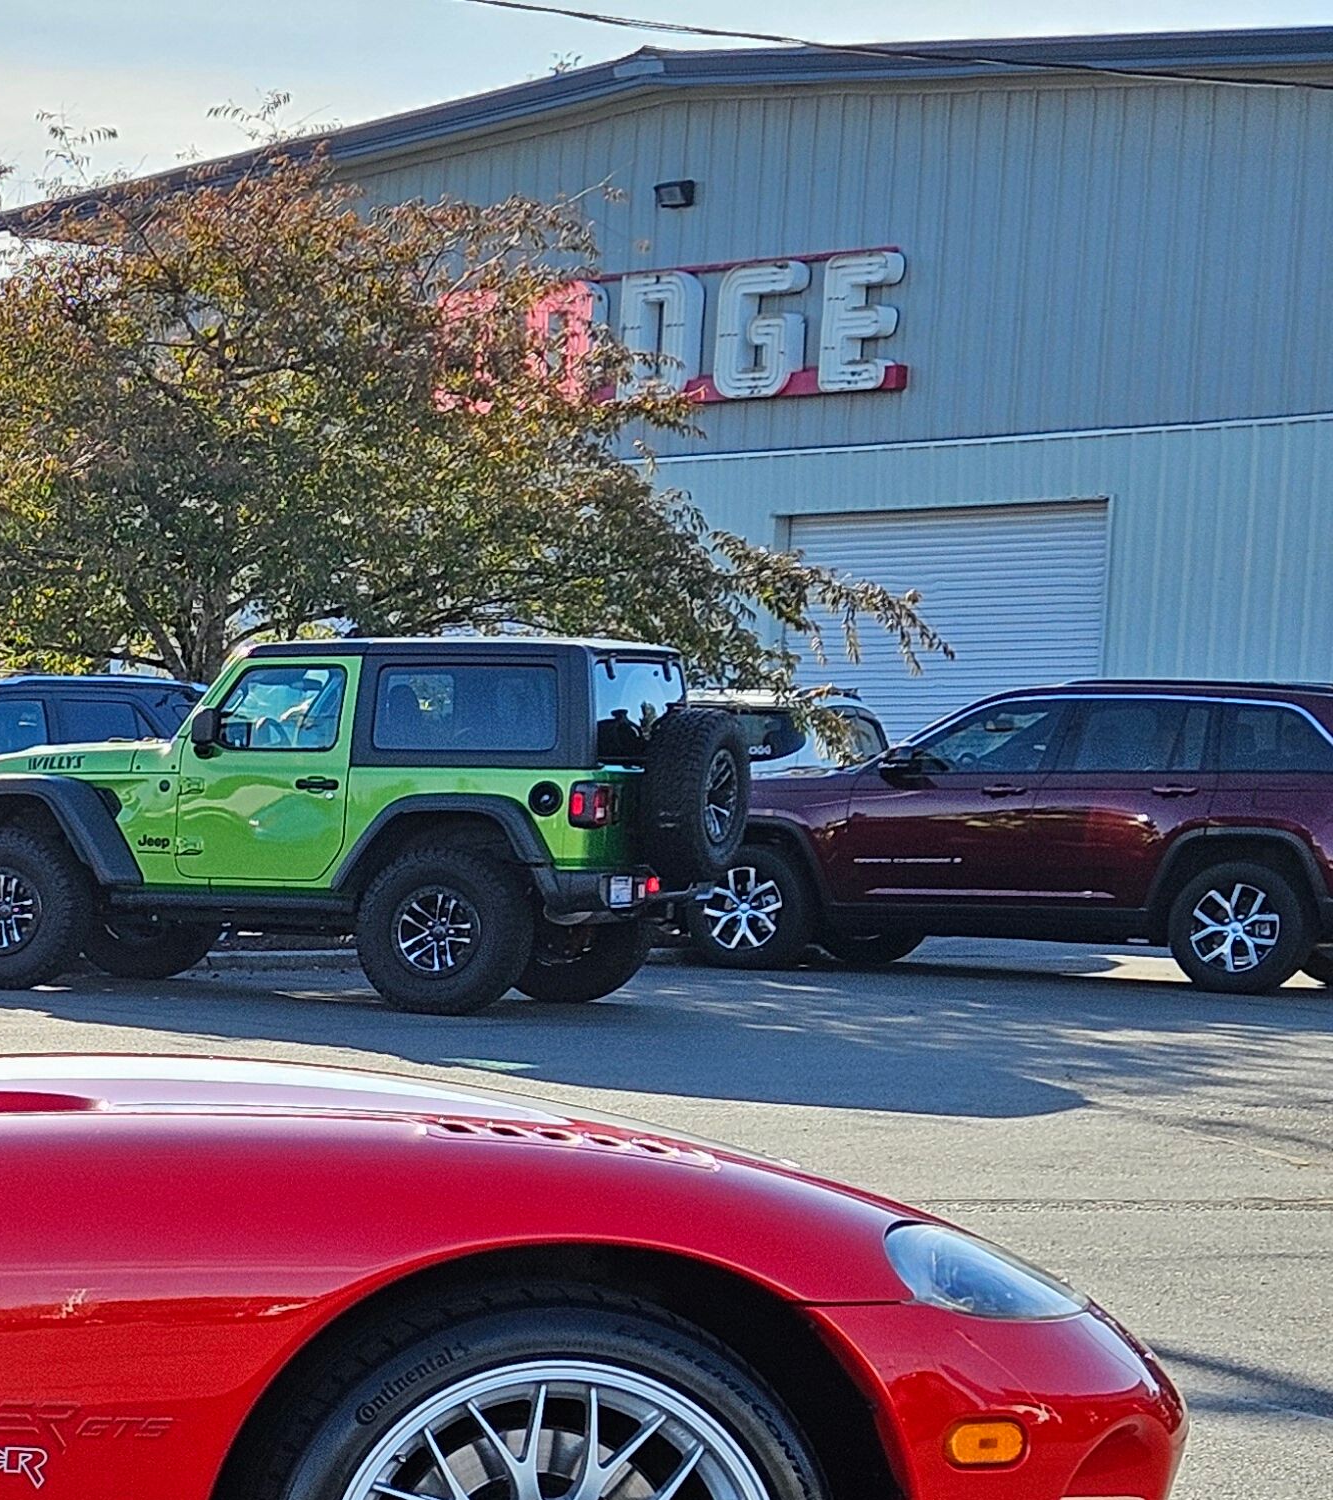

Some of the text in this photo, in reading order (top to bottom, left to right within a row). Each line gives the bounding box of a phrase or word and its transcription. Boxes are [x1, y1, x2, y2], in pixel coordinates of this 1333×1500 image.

[28, 755, 85, 770] WILLYS
[138, 834, 170, 849] Jeep
[355, 1346, 454, 1425] Continental
[76, 1415, 176, 1439] GTS
